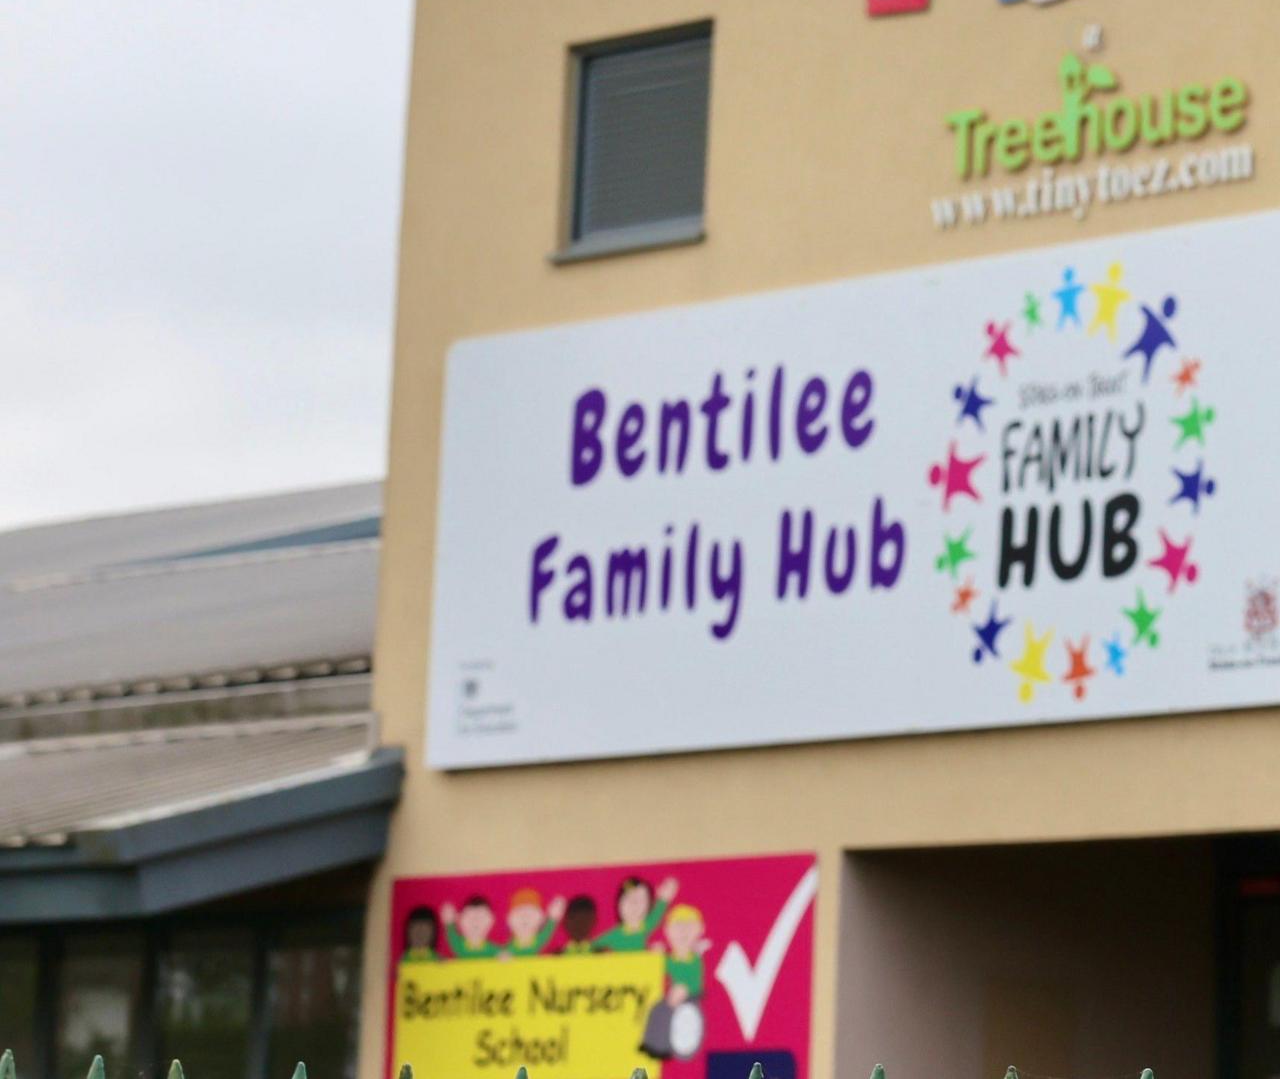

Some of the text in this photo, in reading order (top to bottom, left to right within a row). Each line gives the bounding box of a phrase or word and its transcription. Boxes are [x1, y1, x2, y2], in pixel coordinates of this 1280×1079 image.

[944, 54, 1248, 178] Treehouse
[571, 364, 875, 487] Bentilee
[1001, 403, 1145, 495] FAMILY
[528, 496, 908, 640] Family Hub
[997, 491, 1142, 590] HUB
[403, 976, 650, 1022] Bentilee Nursery
[473, 1025, 570, 1067] School
